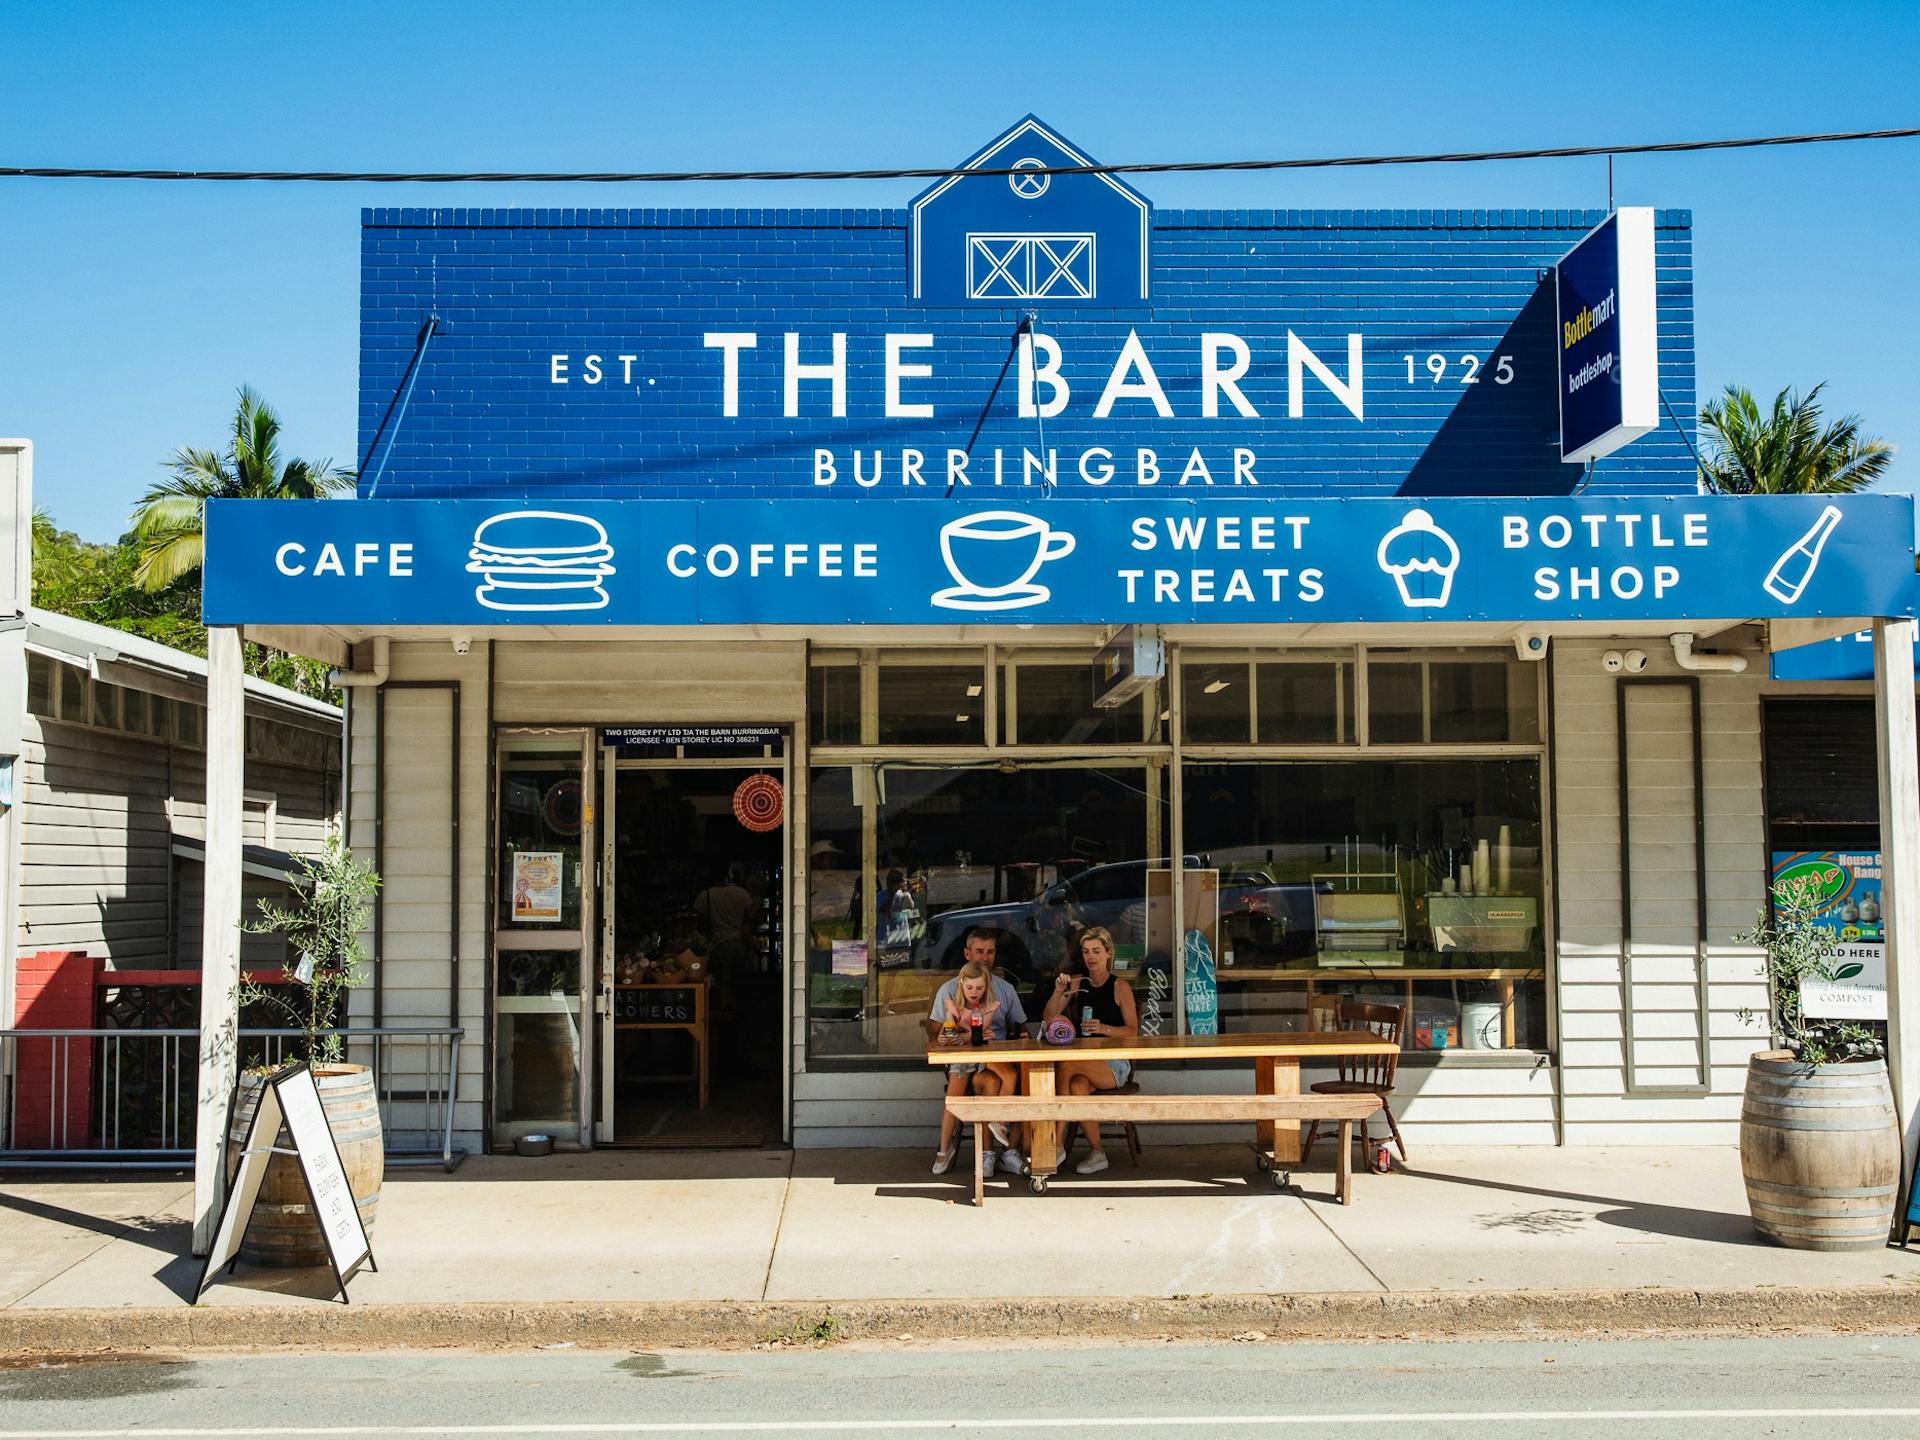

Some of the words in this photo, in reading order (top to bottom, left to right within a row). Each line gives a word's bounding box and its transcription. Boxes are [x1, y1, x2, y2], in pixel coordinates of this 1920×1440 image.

[1564, 287, 1615, 350] Bottlemart
[550, 354, 657, 386] EST.
[703, 332, 935, 419] THE
[1018, 329, 1365, 421] BARN
[1403, 350, 1516, 386] 1925
[1568, 350, 1613, 393] bottleshop
[814, 448, 1260, 488] BURRINGBAR
[1130, 515, 1311, 552] SWEET
[1502, 513, 1709, 549] BOTTLE
[275, 542, 415, 578] CAFE
[666, 543, 880, 579] COFFEE
[1118, 567, 1326, 604] TREATS
[1534, 565, 1680, 601] SHOP
[1838, 854, 1872, 866] House
[1853, 866, 1883, 879] Rang
[1820, 949, 1846, 958] OLD
[1849, 950, 1881, 958] HERE
[1185, 981, 1207, 993] EAST
[1187, 990, 1216, 1003] COAST
[1819, 993, 1875, 1004] COMPOST
[615, 1005, 689, 1021] LOWERS
[1188, 1000, 1212, 1013] HAZE
